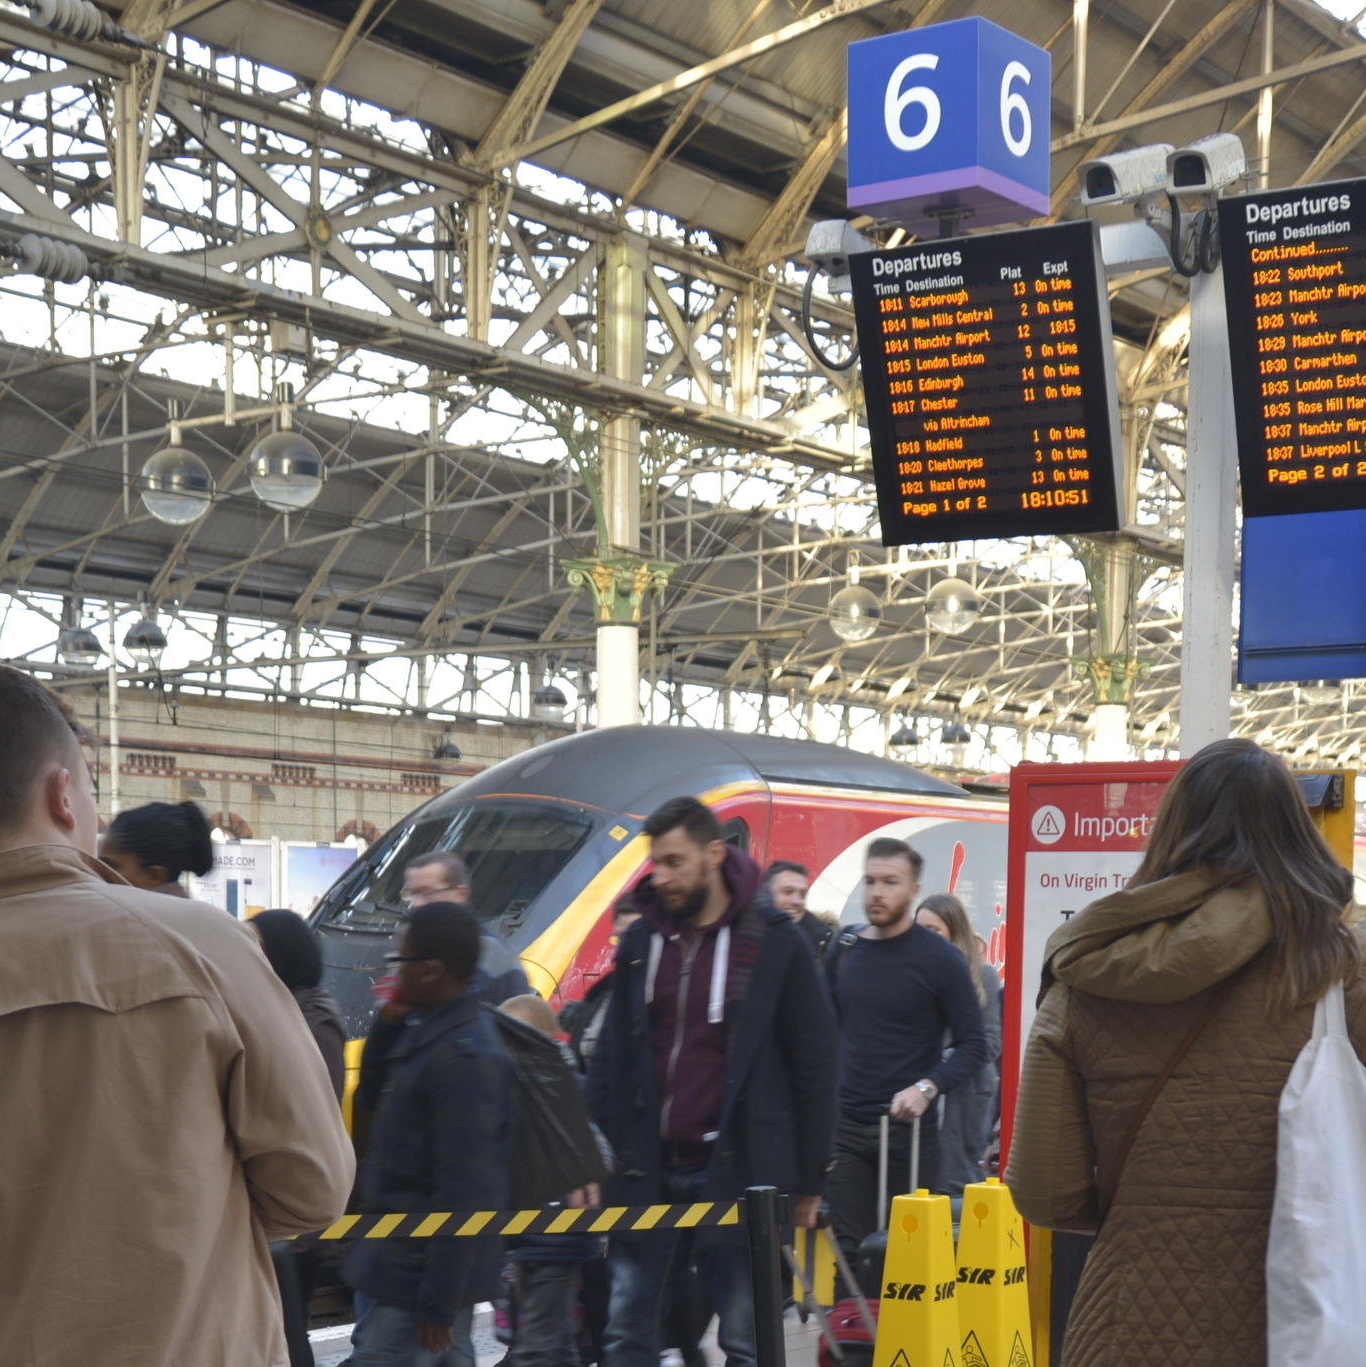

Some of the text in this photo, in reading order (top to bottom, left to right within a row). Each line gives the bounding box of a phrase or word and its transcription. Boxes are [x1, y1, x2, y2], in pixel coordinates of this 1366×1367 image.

[884, 53, 941, 152] 6
[1000, 61, 1032, 157] 6
[1246, 195, 1351, 224] Departures
[1246, 230, 1276, 244] Time
[1283, 220, 1350, 240] Destination
[872, 251, 962, 278] Departures
[1253, 269, 1280, 285] 18:22
[1288, 261, 1343, 281] Southport
[874, 260, 1068, 295] Time Destination Plat Expt
[880, 278, 1071, 312] 18:11 Scarborough 13 On time
[1255, 291, 1282, 307] 18:23
[1289, 286, 1333, 303] Manchtr
[883, 303, 1028, 333] 18:14 New Mills Central 2
[1257, 314, 1284, 330] 18:26
[1290, 310, 1317, 325] York
[885, 319, 1075, 353] 18:14 Manchtr Airport 12 18:15
[1259, 336, 1285, 352] 18:29
[1292, 332, 1337, 348] Manchtr
[887, 346, 1032, 374] 18:15 London Euston 5
[1260, 358, 1287, 374] 18:30
[1294, 353, 1357, 370] Carmarthen
[890, 367, 1034, 394] 18:16 Edinburgh 14
[1262, 381, 1289, 396] 18:35
[1296, 377, 1333, 393] London
[892, 384, 1081, 414] 18:17 Chester 11 On time
[1264, 402, 1290, 418] 18:35
[1297, 401, 1323, 414] Rose
[1326, 398, 1343, 411] Hill
[924, 415, 990, 431] via Altrincham
[1265, 424, 1292, 439] 18:37
[1299, 420, 1342, 436] Manchtr
[897, 430, 1039, 455] 18:18 Hadfield 1
[1267, 446, 1293, 461] 18:37
[1301, 441, 1350, 458] Liverpool
[1354, 441, 1361, 453] L
[899, 450, 1042, 475] 18:20 Cleethorpes 3
[1268, 469, 1307, 484] Page
[1314, 465, 1325, 479] 2
[1332, 463, 1349, 477] of
[901, 471, 1044, 494] 18:21 Hazel Grove 13
[903, 489, 1088, 516] Page 1 of 2 18:10:51
[1040, 873, 1060, 888] On
[1064, 873, 1108, 891] Virgin
